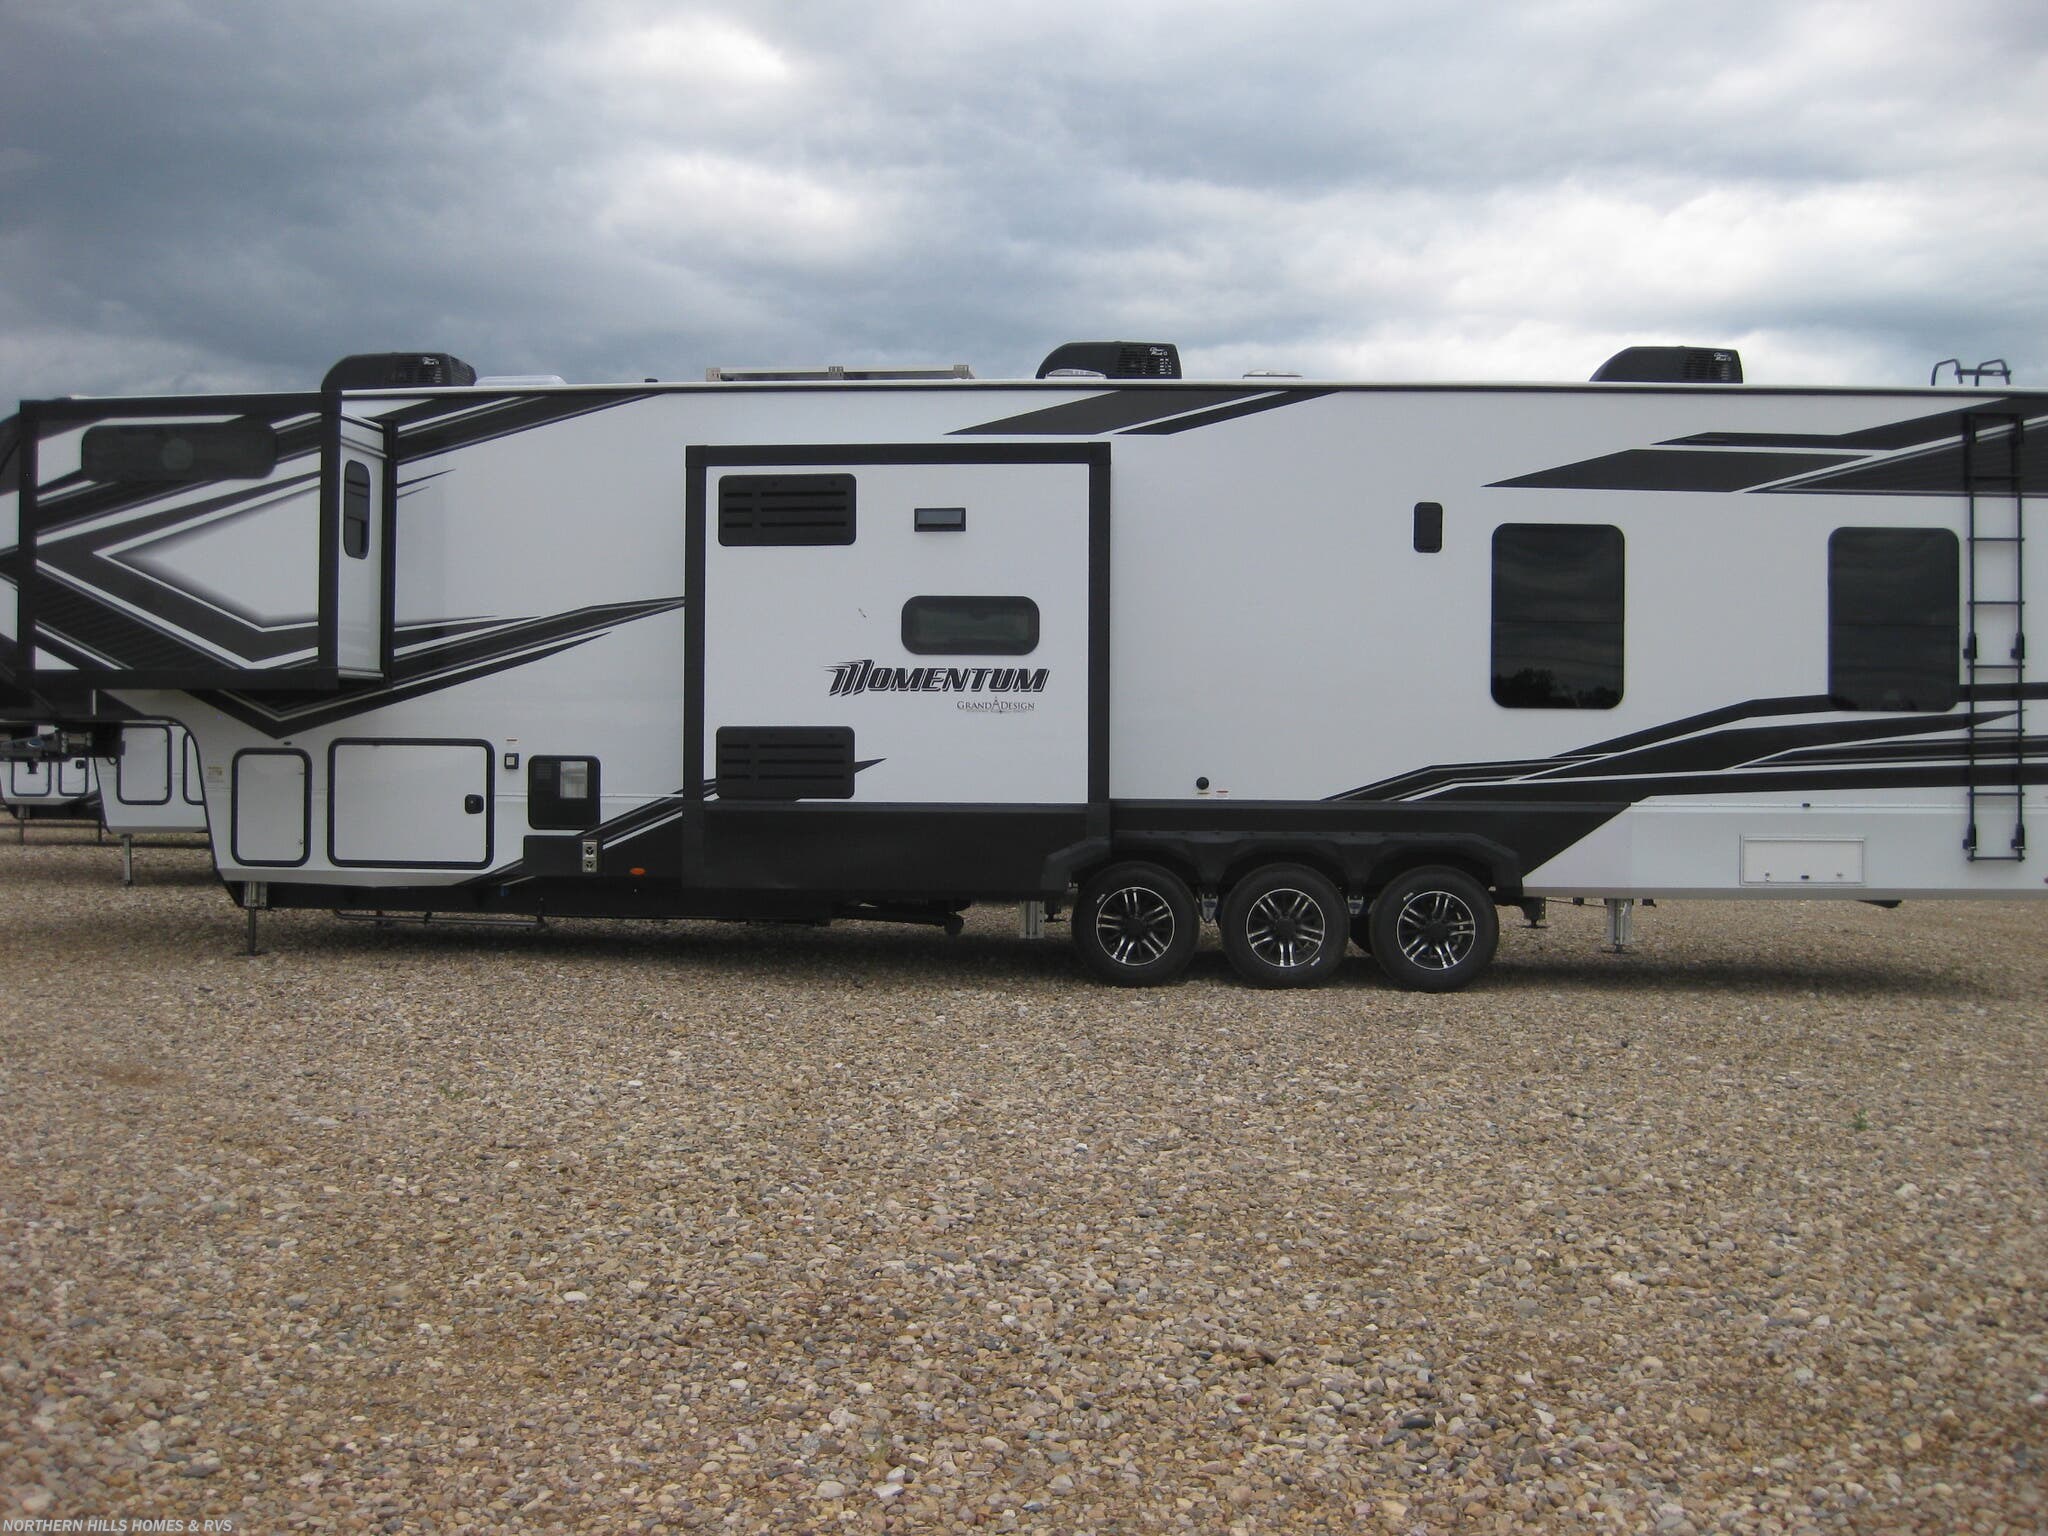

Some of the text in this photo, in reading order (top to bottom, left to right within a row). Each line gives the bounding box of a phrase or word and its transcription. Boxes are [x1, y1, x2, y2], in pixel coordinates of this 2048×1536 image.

[823, 659, 1050, 697] MOMENTUM
[956, 700, 1036, 711] GRAND DESIGN
